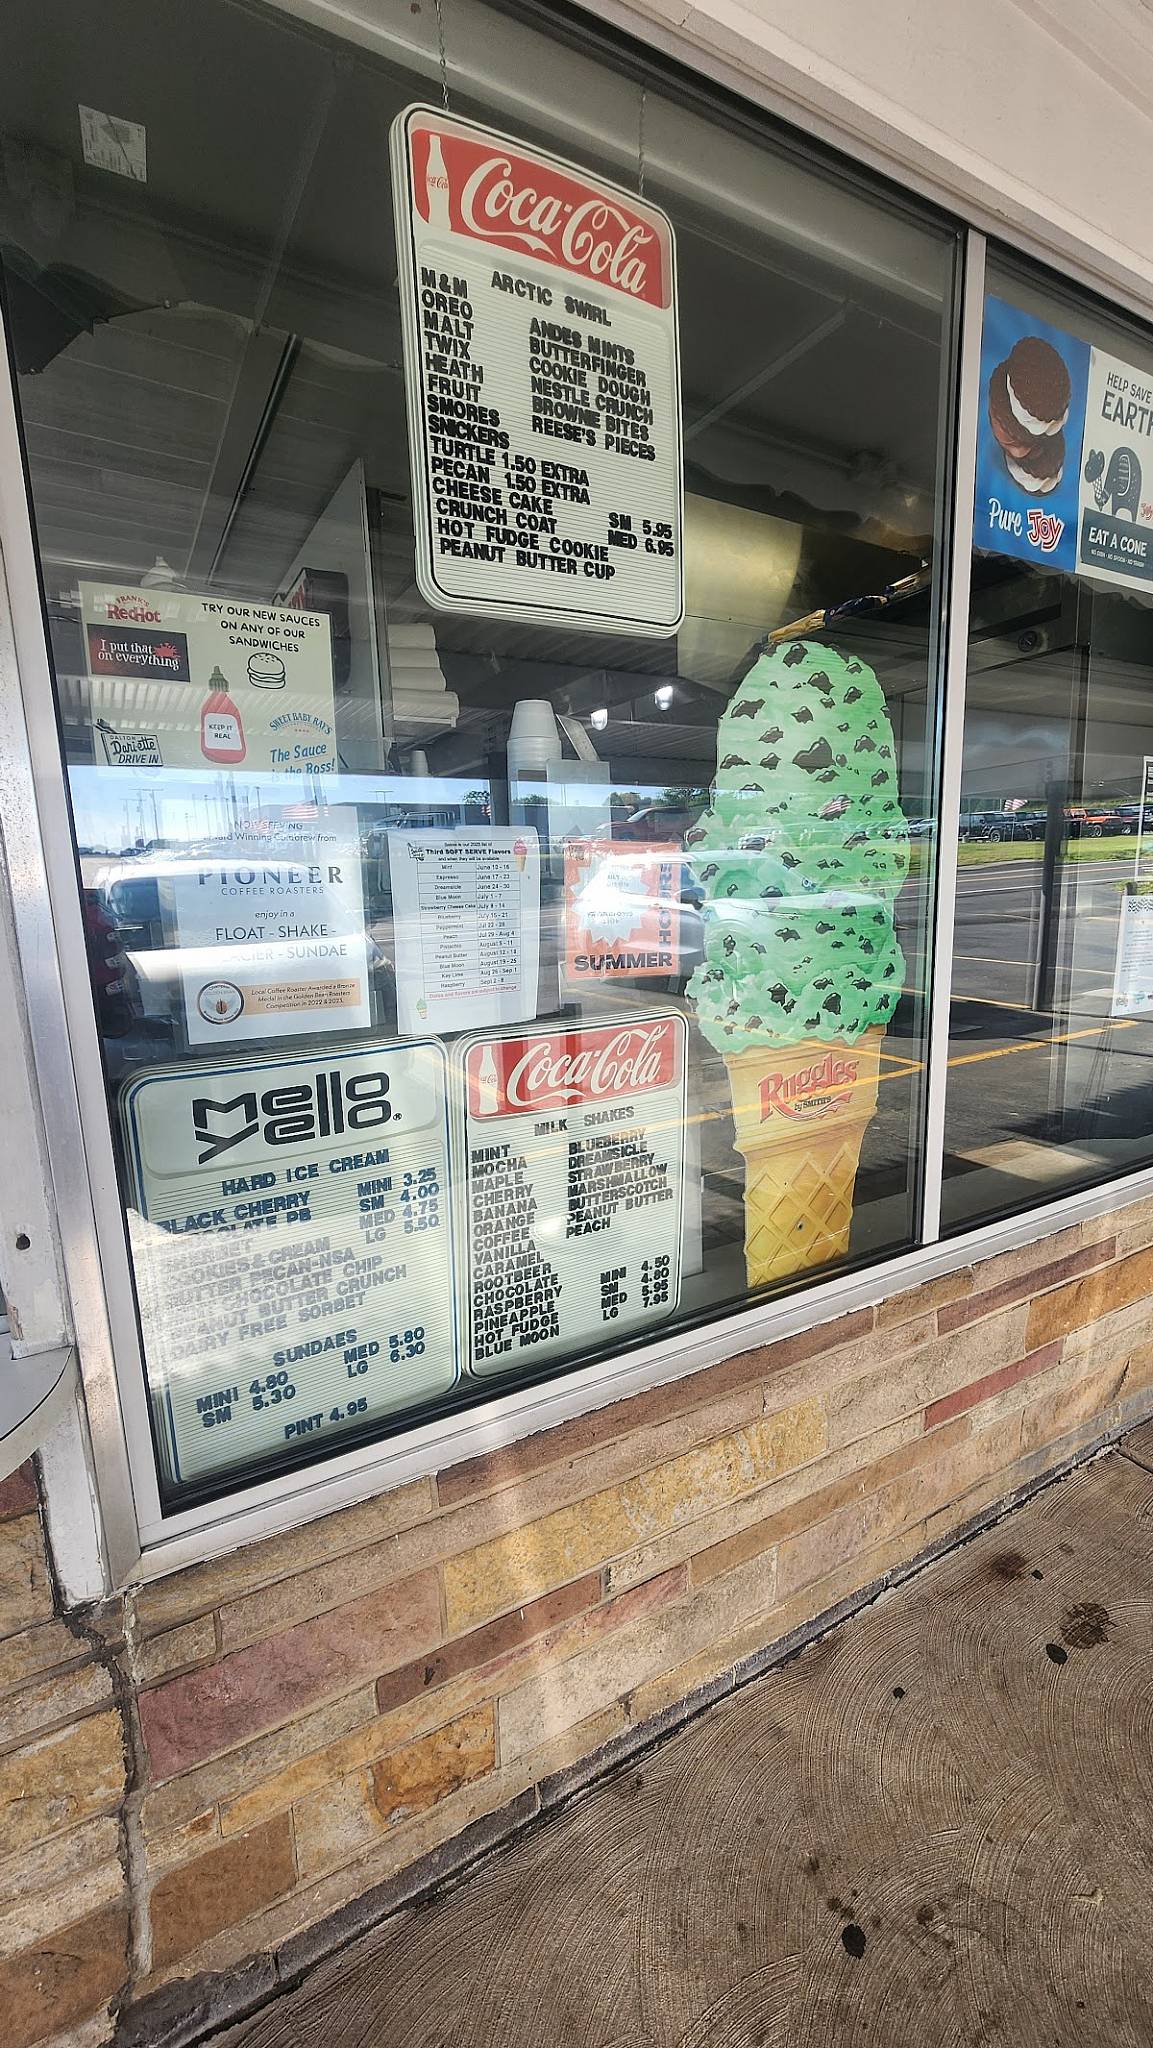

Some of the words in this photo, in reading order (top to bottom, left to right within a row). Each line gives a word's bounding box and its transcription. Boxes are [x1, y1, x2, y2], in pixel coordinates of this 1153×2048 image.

[461, 157, 654, 294] Coca-Cola
[421, 266, 468, 299] M&M
[421, 289, 473, 320] OREO
[491, 271, 553, 306] ARCTIC
[564, 296, 612, 326] SWIRL
[424, 309, 475, 340] MALT
[424, 331, 471, 360] TWIX
[530, 317, 582, 348] ANDES
[588, 335, 635, 365] MINTS
[425, 352, 484, 384] HEATH
[529, 336, 647, 388] BUTTERFINGER
[428, 373, 481, 403] FRUIT
[529, 357, 588, 388] COOKIE
[598, 376, 650, 407] DOUGH
[1107, 371, 1129, 392] HELP
[1130, 383, 1153, 404] SAVE
[427, 394, 500, 427] SMORES
[531, 376, 590, 407] NESTLE
[595, 394, 653, 425] CRUNCH
[428, 414, 510, 450] SNICKERS
[532, 415, 597, 447] REESE'S
[604, 433, 656, 461] PIECES
[605, 415, 649, 441] BITES
[430, 435, 496, 466] TURTLE
[501, 452, 536, 475] 1.50
[540, 460, 590, 487] EXTRA
[431, 456, 490, 484] PECAN
[504, 472, 536, 493] 1.50
[541, 478, 591, 505] EXTRA
[432, 477, 502, 505] CHEESE
[509, 491, 553, 516] CAKE
[436, 498, 507, 526] CRUNCH
[516, 513, 557, 534] COAT
[608, 512, 632, 532] SM
[642, 519, 673, 539] 5.95
[989, 497, 1023, 537] Pure
[437, 518, 475, 539] HOT
[486, 525, 540, 550] FUDGE
[549, 537, 609, 562] COOKIE
[608, 530, 638, 550] MED
[645, 537, 675, 557] 6.95
[1088, 526, 1109, 546] EAT
[1110, 533, 1117, 549] A
[1120, 536, 1147, 557] CONE
[440, 538, 505, 563] PEANUT
[516, 550, 577, 575] BUTTER
[584, 561, 615, 580] CUP
[202, 602, 223, 613] TRY
[227, 604, 250, 617] OUR
[252, 608, 277, 622] NEW
[279, 612, 321, 627] SAUCES
[220, 619, 237, 630] ON
[240, 622, 264, 635] ANY
[267, 625, 281, 636] OF
[283, 627, 306, 639] OUR
[100, 638, 107, 652] I
[109, 642, 129, 653] put
[130, 642, 153, 655] that
[228, 635, 300, 653] SANDWICHES
[98, 652, 113, 661] on
[116, 652, 180, 672] everything
[269, 713, 292, 731] SWEET
[119, 754, 147, 764] DRIVE
[148, 754, 159, 764] IN
[270, 748, 290, 763] The
[294, 744, 327, 759] Sauce
[305, 757, 335, 775] Boss!
[221, 886, 265, 896] COFFEE
[269, 886, 324, 896] ROASTERS
[215, 926, 265, 941] FLOAT
[278, 924, 328, 938] SHAKE
[287, 944, 348, 960] SUNDAE
[574, 952, 673, 972] SUMMER
[506, 1024, 669, 1107] Coca-Cola
[758, 1052, 859, 1124] Ruggles
[534, 1118, 568, 1137] MILK
[584, 1106, 635, 1127] SHAKES
[471, 1144, 511, 1164] MINT
[568, 1128, 647, 1156] BLUEBERRY
[568, 1141, 648, 1170] DREAMSICLE
[222, 1172, 276, 1196] HARD
[286, 1163, 319, 1183] ICE
[329, 1148, 389, 1174] CREAM
[357, 1177, 392, 1198] MINI
[402, 1168, 437, 1187] 3.25
[472, 1156, 528, 1179] MOCHA
[472, 1171, 524, 1194] MAPLE
[567, 1163, 668, 1198] MARSHMALLOW
[568, 1153, 655, 1184] STRAWBERRY
[234, 1191, 310, 1222] CHERRY
[360, 1196, 385, 1212] SM
[400, 1182, 439, 1203] 4.00
[473, 1184, 533, 1208] CHERRY
[566, 1202, 619, 1225] PEANUT
[625, 1187, 674, 1211] BUTTER
[568, 1176, 667, 1212] BUTTERSCOTCH
[286, 1208, 312, 1223] PB
[359, 1210, 395, 1230] MED
[402, 1202, 438, 1219] 4.75
[473, 1198, 538, 1224] BANANA
[473, 1212, 535, 1238] ORANGE
[365, 1228, 387, 1244] LG
[404, 1214, 439, 1234] 5.50
[473, 1226, 530, 1251] COFFEE
[565, 1217, 611, 1239] PEACH
[343, 1255, 384, 1278] CHIP
[473, 1251, 544, 1280] CARAMEL
[474, 1240, 536, 1265] VANILLA
[336, 1264, 407, 1297] CRUNCH
[473, 1262, 552, 1294] ROOTBEER
[600, 1266, 627, 1285] MINI
[641, 1254, 670, 1272] 4.50
[600, 1281, 618, 1297] SM
[641, 1267, 670, 1285] 4.80
[473, 1273, 559, 1308] CHOCOLATE
[473, 1285, 563, 1322] RASPBERRY
[600, 1292, 628, 1310] MED
[641, 1279, 669, 1297] 5.95
[602, 1306, 619, 1321] LG
[642, 1291, 669, 1309] 7.95
[239, 1315, 288, 1341] FREE
[298, 1292, 366, 1323] SORBET
[474, 1300, 555, 1335] PINEAPPLE
[474, 1328, 504, 1348] HOT
[511, 1312, 559, 1336] FUDGE
[272, 1329, 357, 1367] SUNDAES
[343, 1341, 380, 1365] MED
[389, 1326, 425, 1350] 5.80
[474, 1339, 512, 1361] BLUE
[519, 1324, 560, 1347] MOON
[347, 1361, 368, 1379] LG
[390, 1341, 426, 1363] 6.30
[196, 1386, 239, 1414] MINI
[249, 1371, 289, 1395] 4.80
[202, 1407, 232, 1428] SM
[252, 1385, 296, 1411] 5.30
[284, 1413, 324, 1440] PINT
[329, 1397, 368, 1422] 4.95
